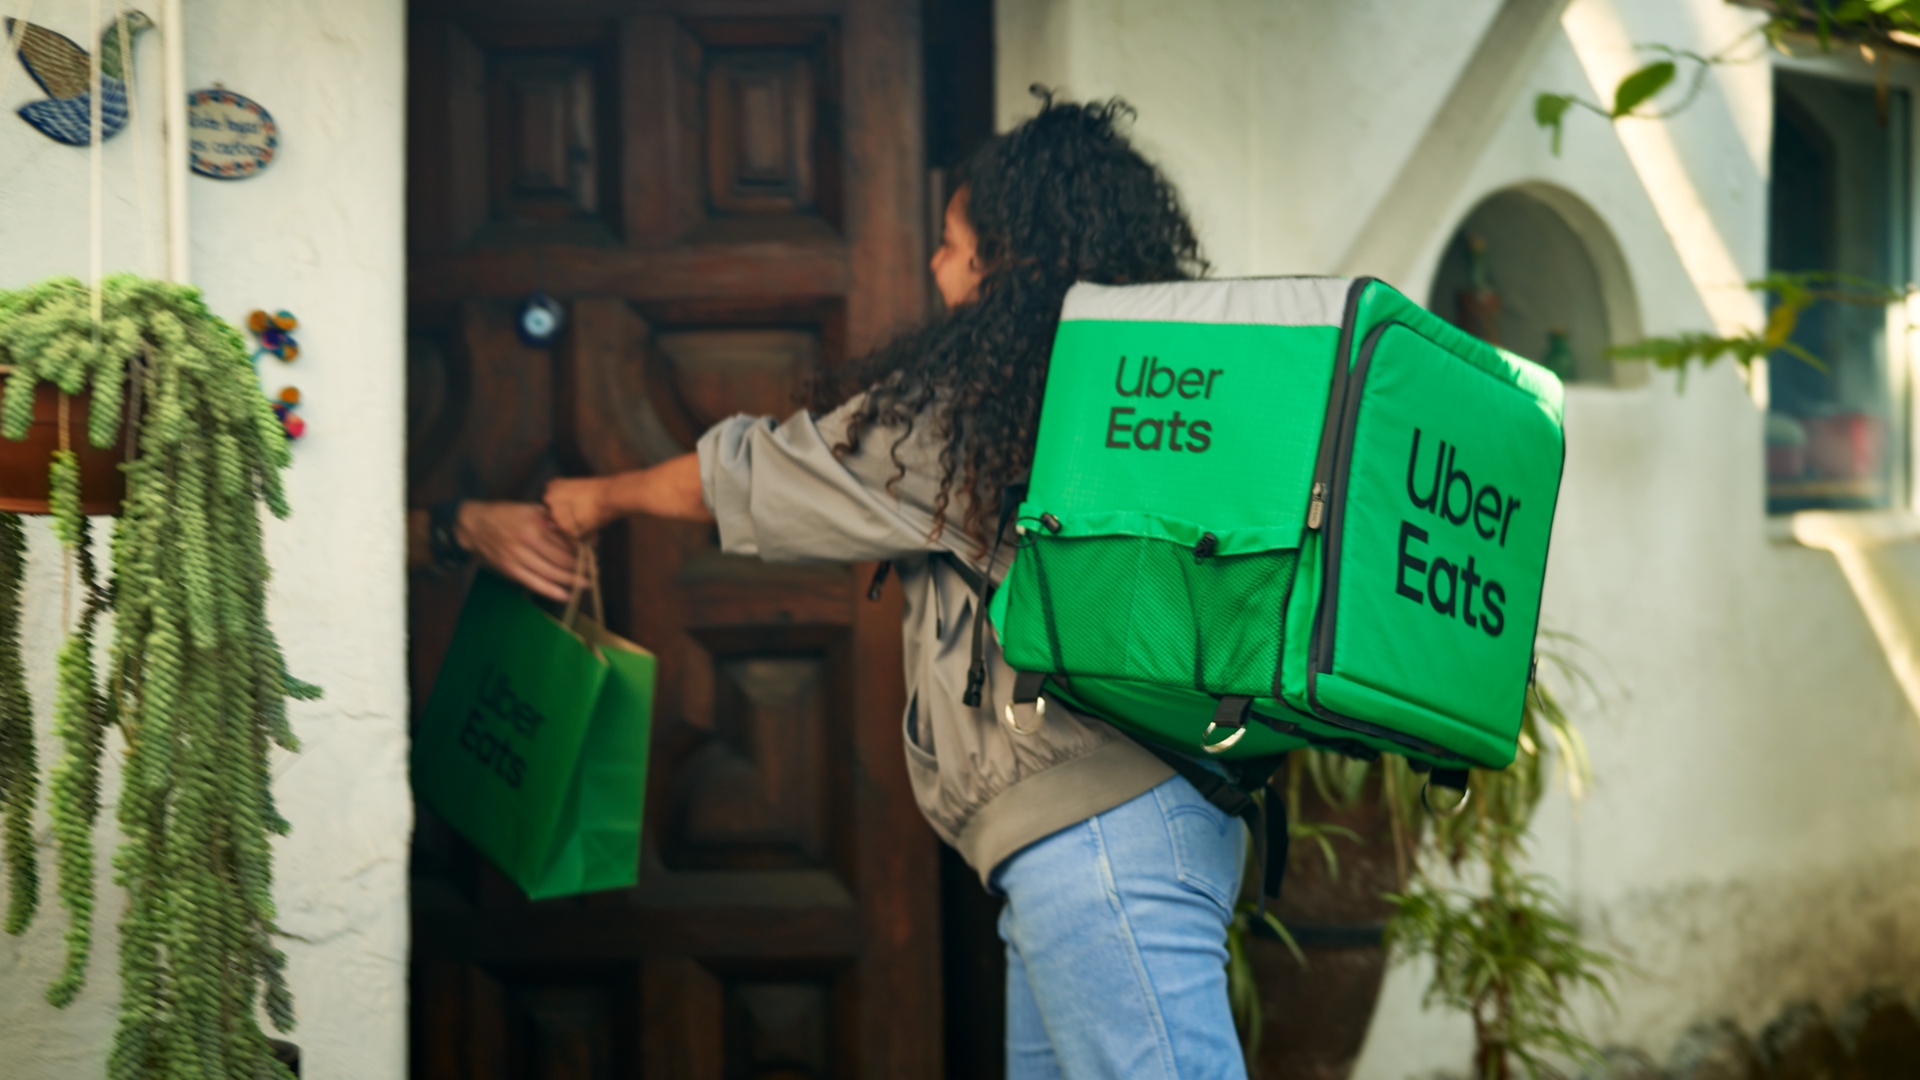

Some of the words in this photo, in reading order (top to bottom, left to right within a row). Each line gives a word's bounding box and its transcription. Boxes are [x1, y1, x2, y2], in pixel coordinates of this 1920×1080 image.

[1115, 355, 1224, 400] Uber
[1104, 406, 1213, 454] Eats
[1405, 426, 1522, 548] Uber
[1394, 519, 1508, 639] Eats
[478, 662, 544, 740] Uber
[460, 708, 527, 787] Eats
